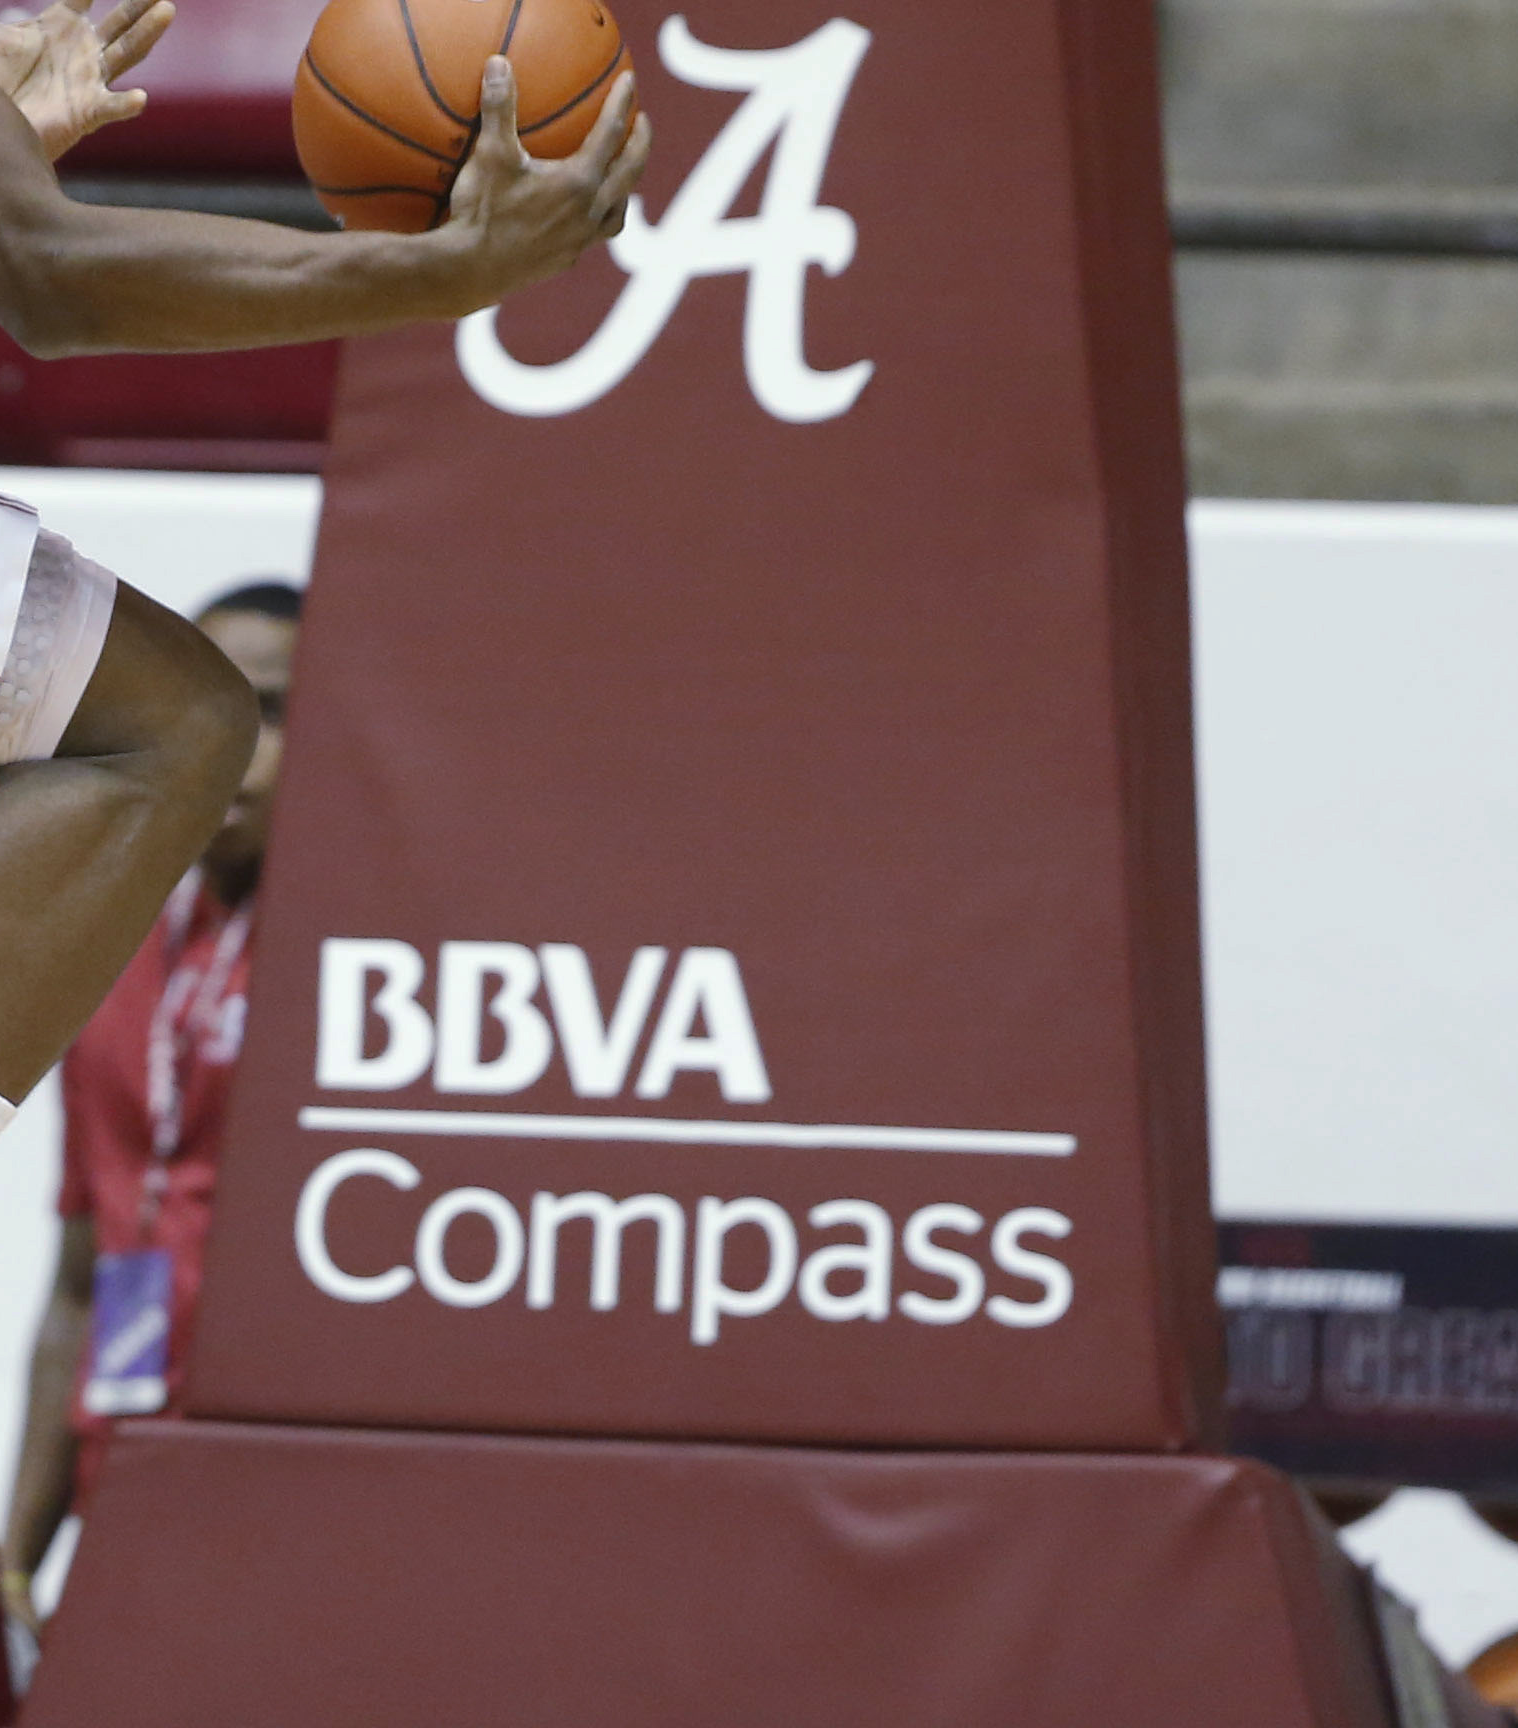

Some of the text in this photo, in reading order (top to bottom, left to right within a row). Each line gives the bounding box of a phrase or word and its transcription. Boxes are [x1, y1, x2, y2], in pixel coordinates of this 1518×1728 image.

[454, 12, 876, 425] A
[314, 936, 772, 1103] BBVA
[294, 1148, 1075, 1346] Compass
